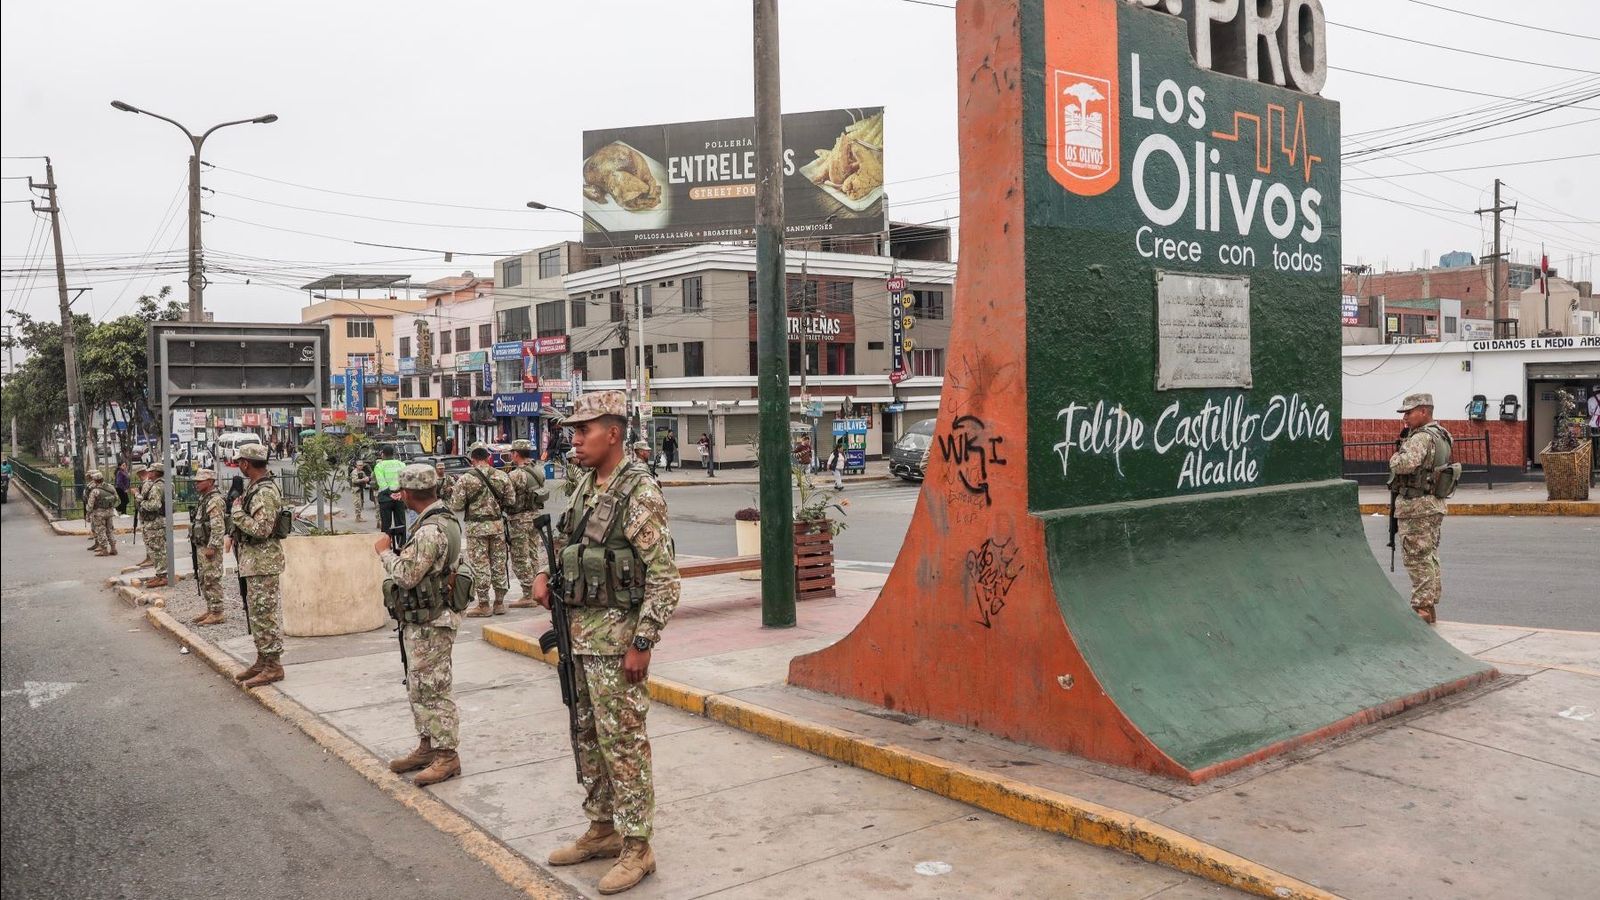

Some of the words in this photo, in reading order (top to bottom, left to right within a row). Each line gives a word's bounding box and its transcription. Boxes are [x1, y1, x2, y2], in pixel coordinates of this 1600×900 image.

[1195, 0, 1327, 95] PRO
[1131, 52, 1207, 129] Los
[705, 138, 753, 149] POLLERÍA
[1065, 144, 1077, 161] LOS
[1079, 147, 1104, 165] OLIVOS
[668, 149, 795, 184] ENTRELES
[694, 188, 732, 198] STREET
[735, 186, 756, 196] FOO
[1131, 133, 1322, 243] Olivos
[703, 229, 742, 237] BROASTERS
[785, 223, 833, 232] SANDWICHES
[1135, 225, 1202, 262] Crece
[1218, 244, 1255, 267] con
[1272, 243, 1322, 272] todos
[893, 294, 901, 369] HOSTEL
[1473, 339, 1526, 350] CUIDAMOS
[1531, 339, 1541, 348] EL
[1544, 338, 1574, 348] MEDIO
[407, 403, 433, 416] Inkafarma
[521, 402, 538, 412] SALUD
[1053, 399, 1144, 477] Felipe
[1154, 394, 1260, 454] Castillo
[1260, 392, 1332, 441] Oliva
[1176, 447, 1258, 489] Alcalde
